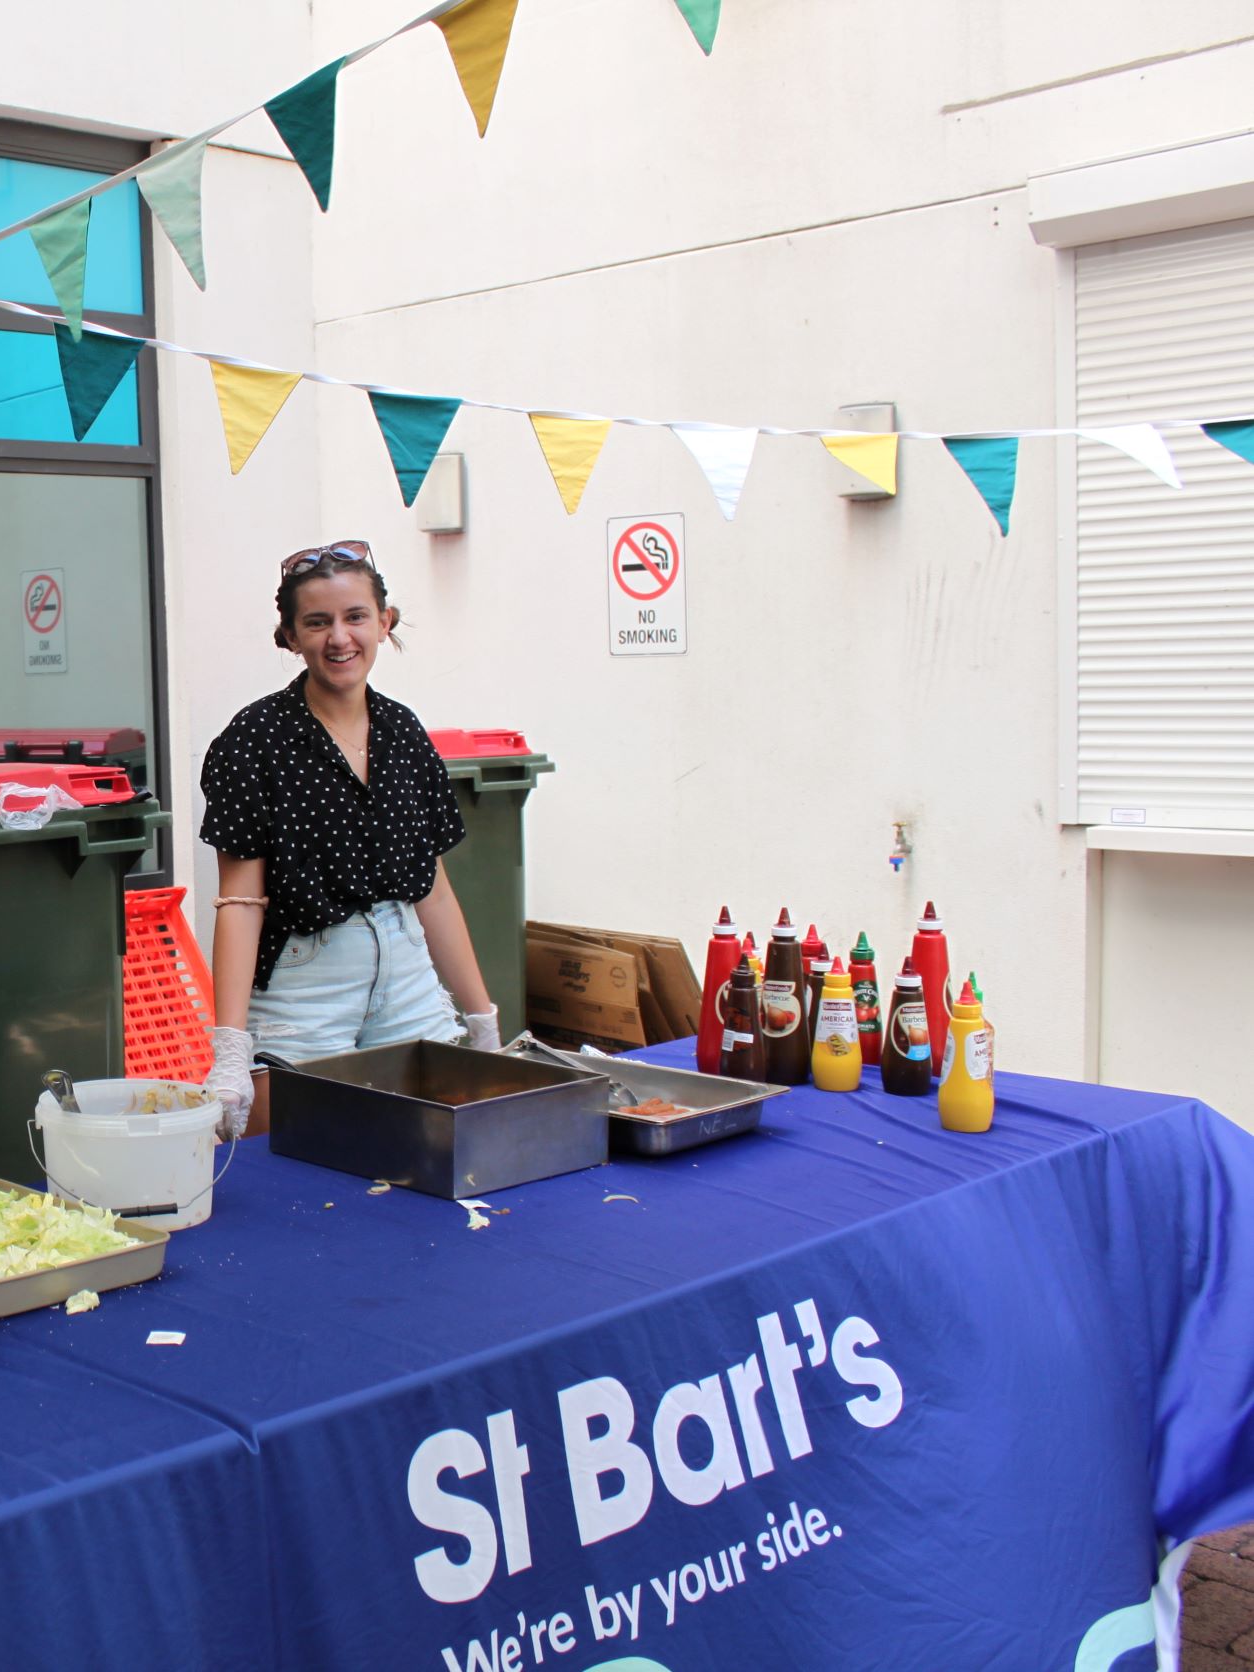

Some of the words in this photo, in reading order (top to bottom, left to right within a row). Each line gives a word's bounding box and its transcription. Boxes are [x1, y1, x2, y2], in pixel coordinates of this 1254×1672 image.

[638, 609, 656, 624] NO
[618, 628, 677, 645] SMOKING
[821, 1015, 854, 1024] AMERICAN
[407, 1409, 532, 1603] St
[557, 1298, 903, 1546] Bart's
[441, 1611, 577, 1672] We're
[584, 1583, 642, 1641] by
[649, 1540, 747, 1627] your
[755, 1500, 844, 1571] side.
